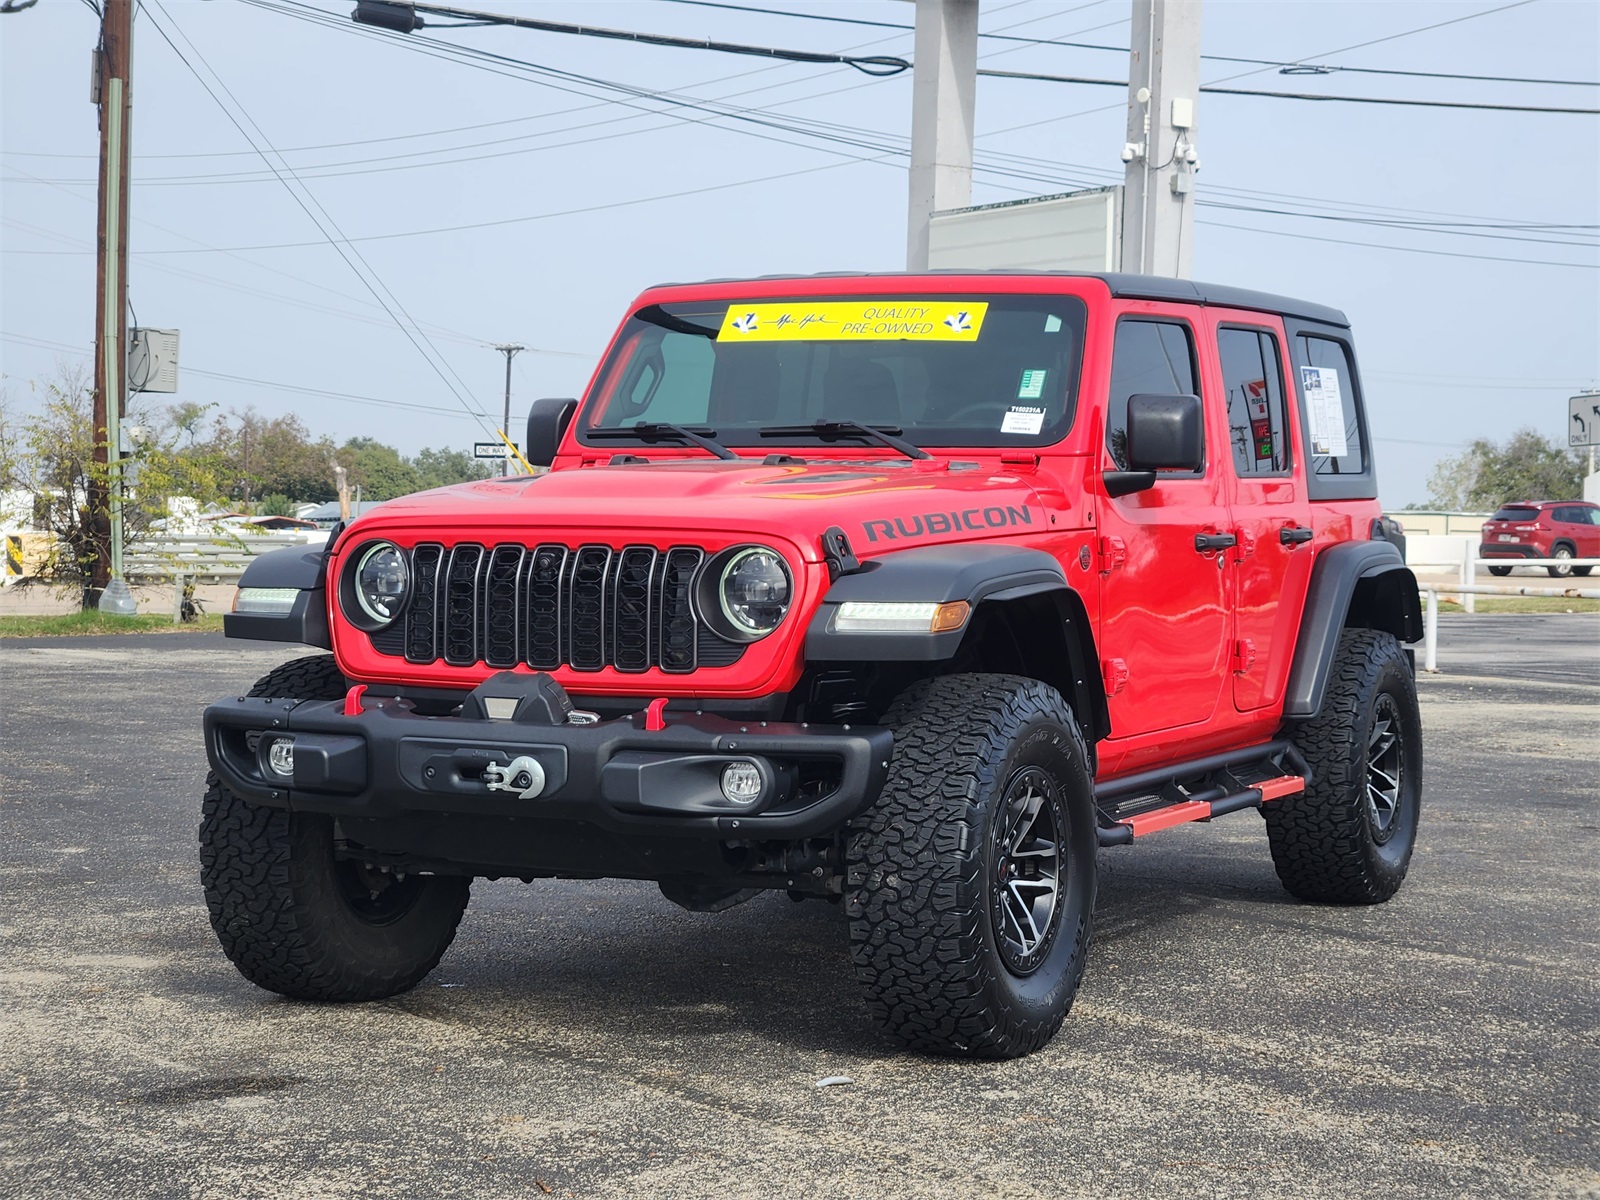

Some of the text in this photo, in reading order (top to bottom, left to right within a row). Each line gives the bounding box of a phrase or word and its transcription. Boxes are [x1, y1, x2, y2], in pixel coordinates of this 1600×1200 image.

[863, 307, 930, 319] QUALITY
[841, 322, 934, 334] PRE-OWNED
[1571, 434, 1588, 443] ONLY
[492, 447, 505, 455] WAY
[862, 505, 1033, 542] RUBICON
